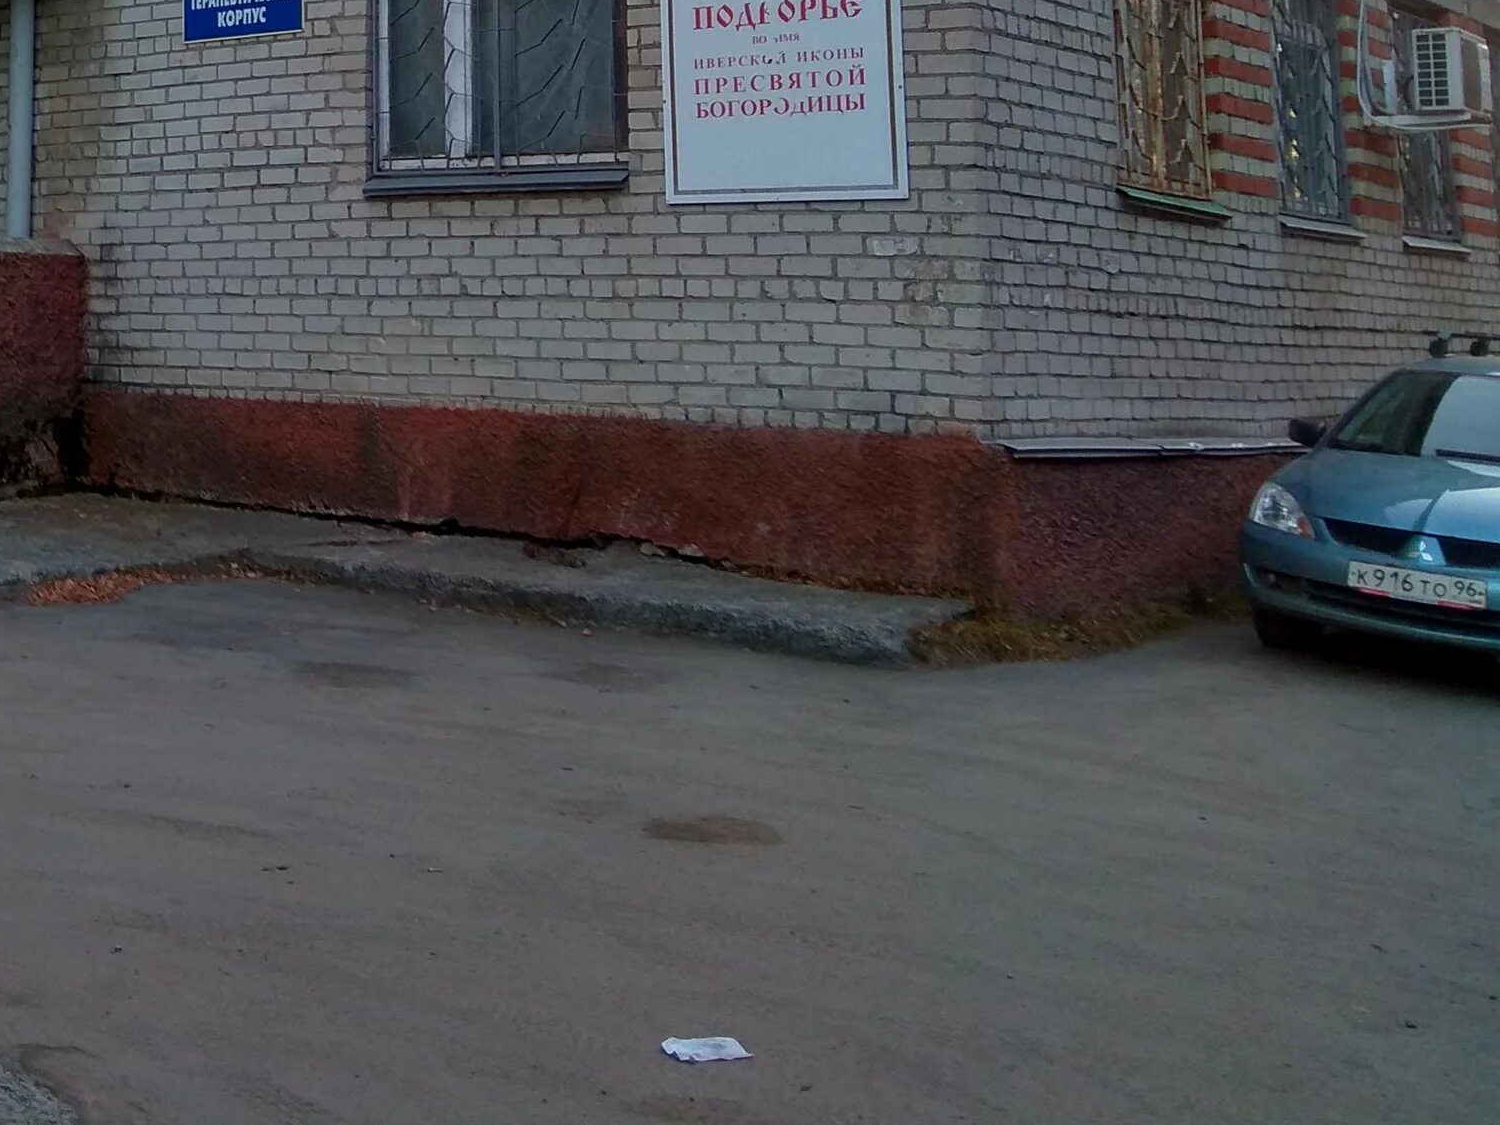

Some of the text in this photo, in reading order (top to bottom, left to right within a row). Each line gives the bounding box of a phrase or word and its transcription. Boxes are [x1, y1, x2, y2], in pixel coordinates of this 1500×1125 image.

[217, 6, 267, 28] КОРПУС
[752, 35, 767, 45] ВО
[797, 47, 864, 63] ИКОНЫ
[694, 64, 866, 95] ПРЕСВЯТОЙ
